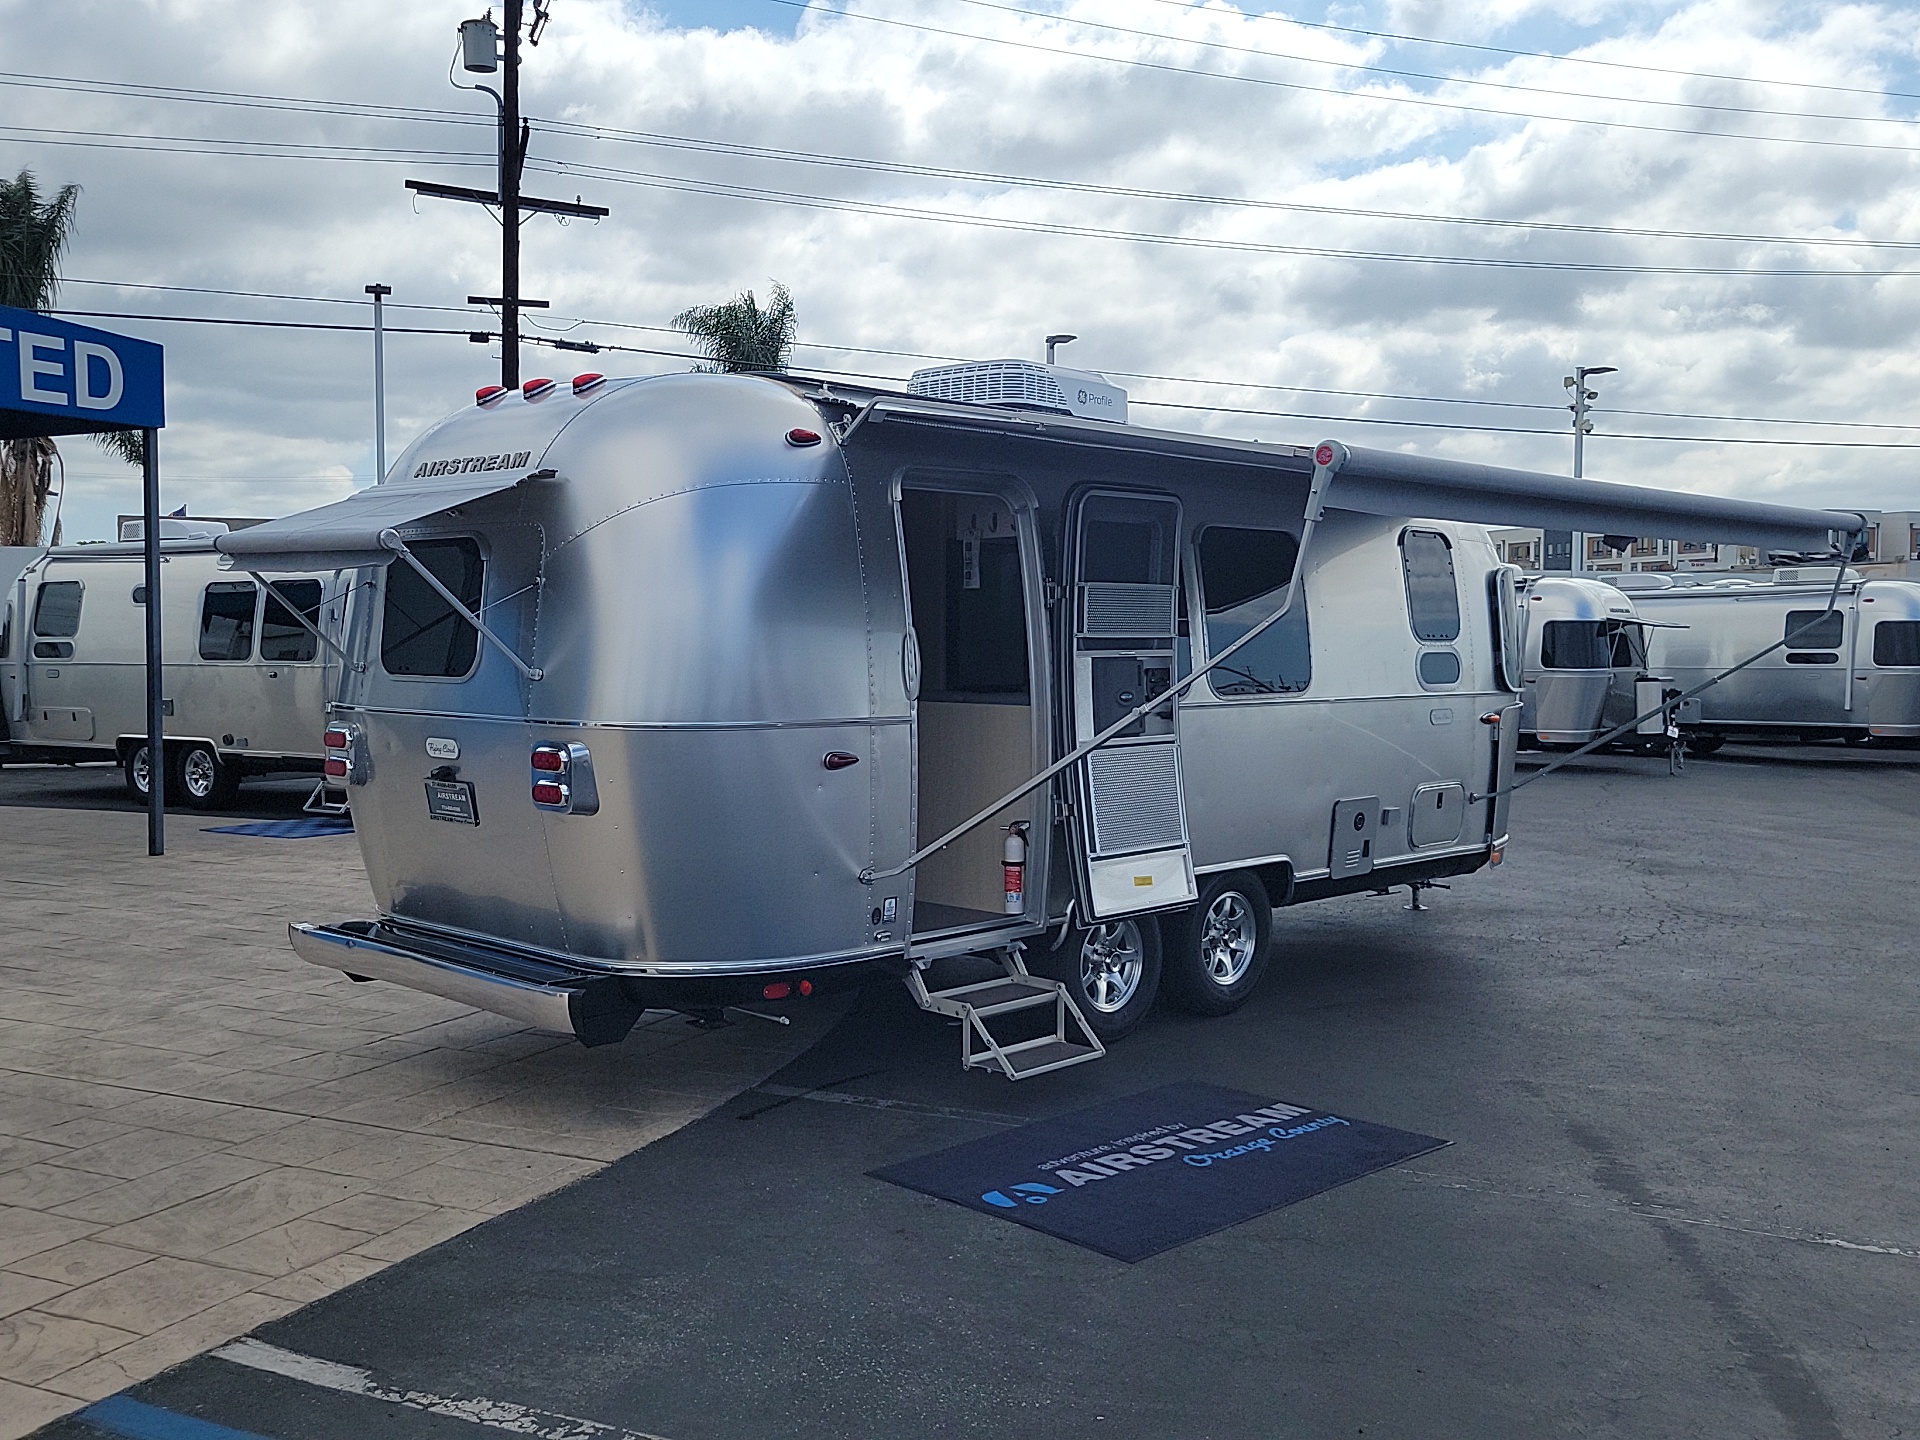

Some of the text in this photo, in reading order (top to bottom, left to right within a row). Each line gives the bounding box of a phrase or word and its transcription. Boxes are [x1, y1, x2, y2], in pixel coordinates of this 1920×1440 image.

[0, 327, 125, 410] ED
[1088, 393, 1113, 407] Profile
[413, 450, 532, 479] AIRSTREAM
[437, 791, 467, 802] AIRSTREAM
[1162, 1122, 1189, 1131] by
[1183, 1115, 1351, 1167] Orange County
[1055, 1102, 1313, 1188] AIRSTREAM
